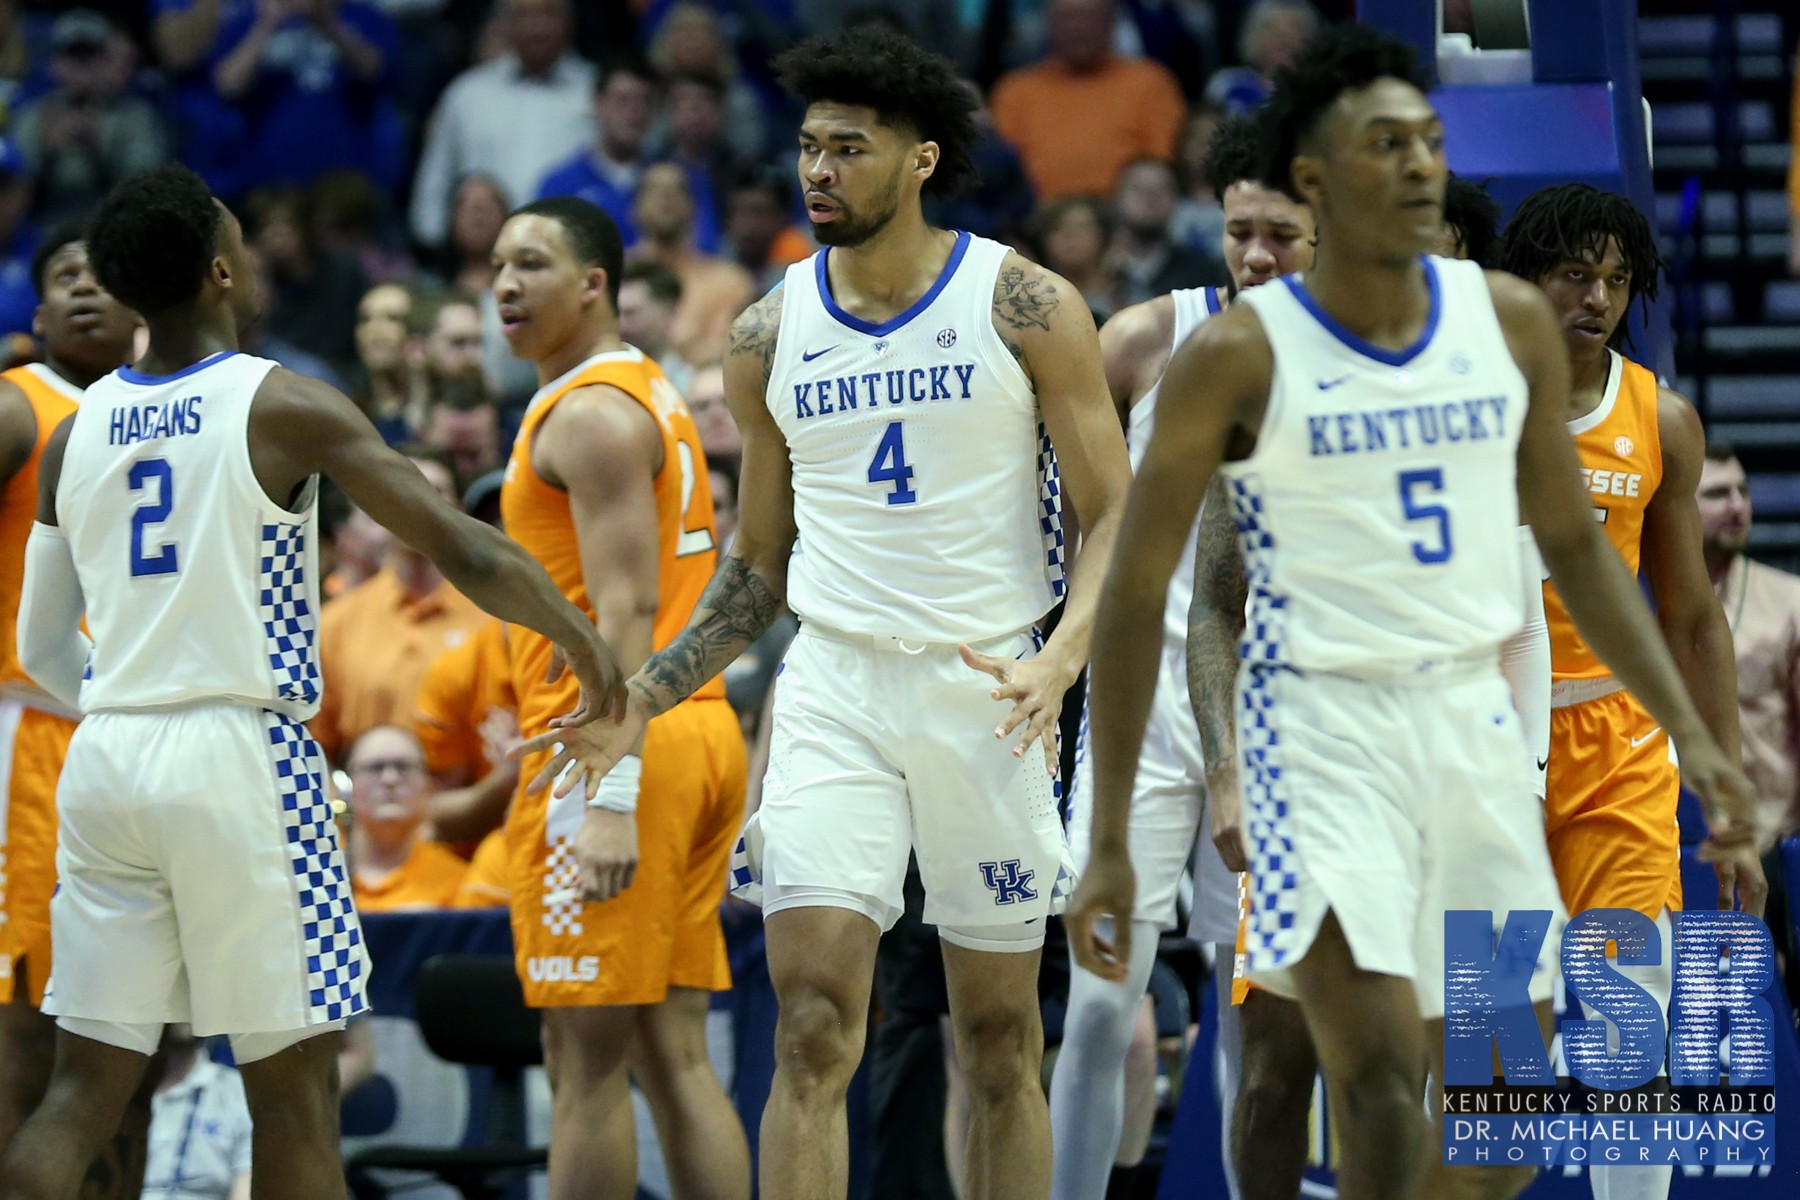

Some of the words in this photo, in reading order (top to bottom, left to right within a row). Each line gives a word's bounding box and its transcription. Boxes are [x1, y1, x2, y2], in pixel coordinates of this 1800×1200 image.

[937, 328, 957, 348] SEC
[794, 364, 975, 420] KENTUCKY
[109, 396, 202, 445] HAGANS
[1307, 396, 1508, 456] KENTUCKY
[867, 421, 917, 506] 4
[128, 458, 179, 577] 2
[1396, 466, 1454, 566] 5
[979, 858, 1039, 906] UK
[527, 955, 600, 983] VOLS
